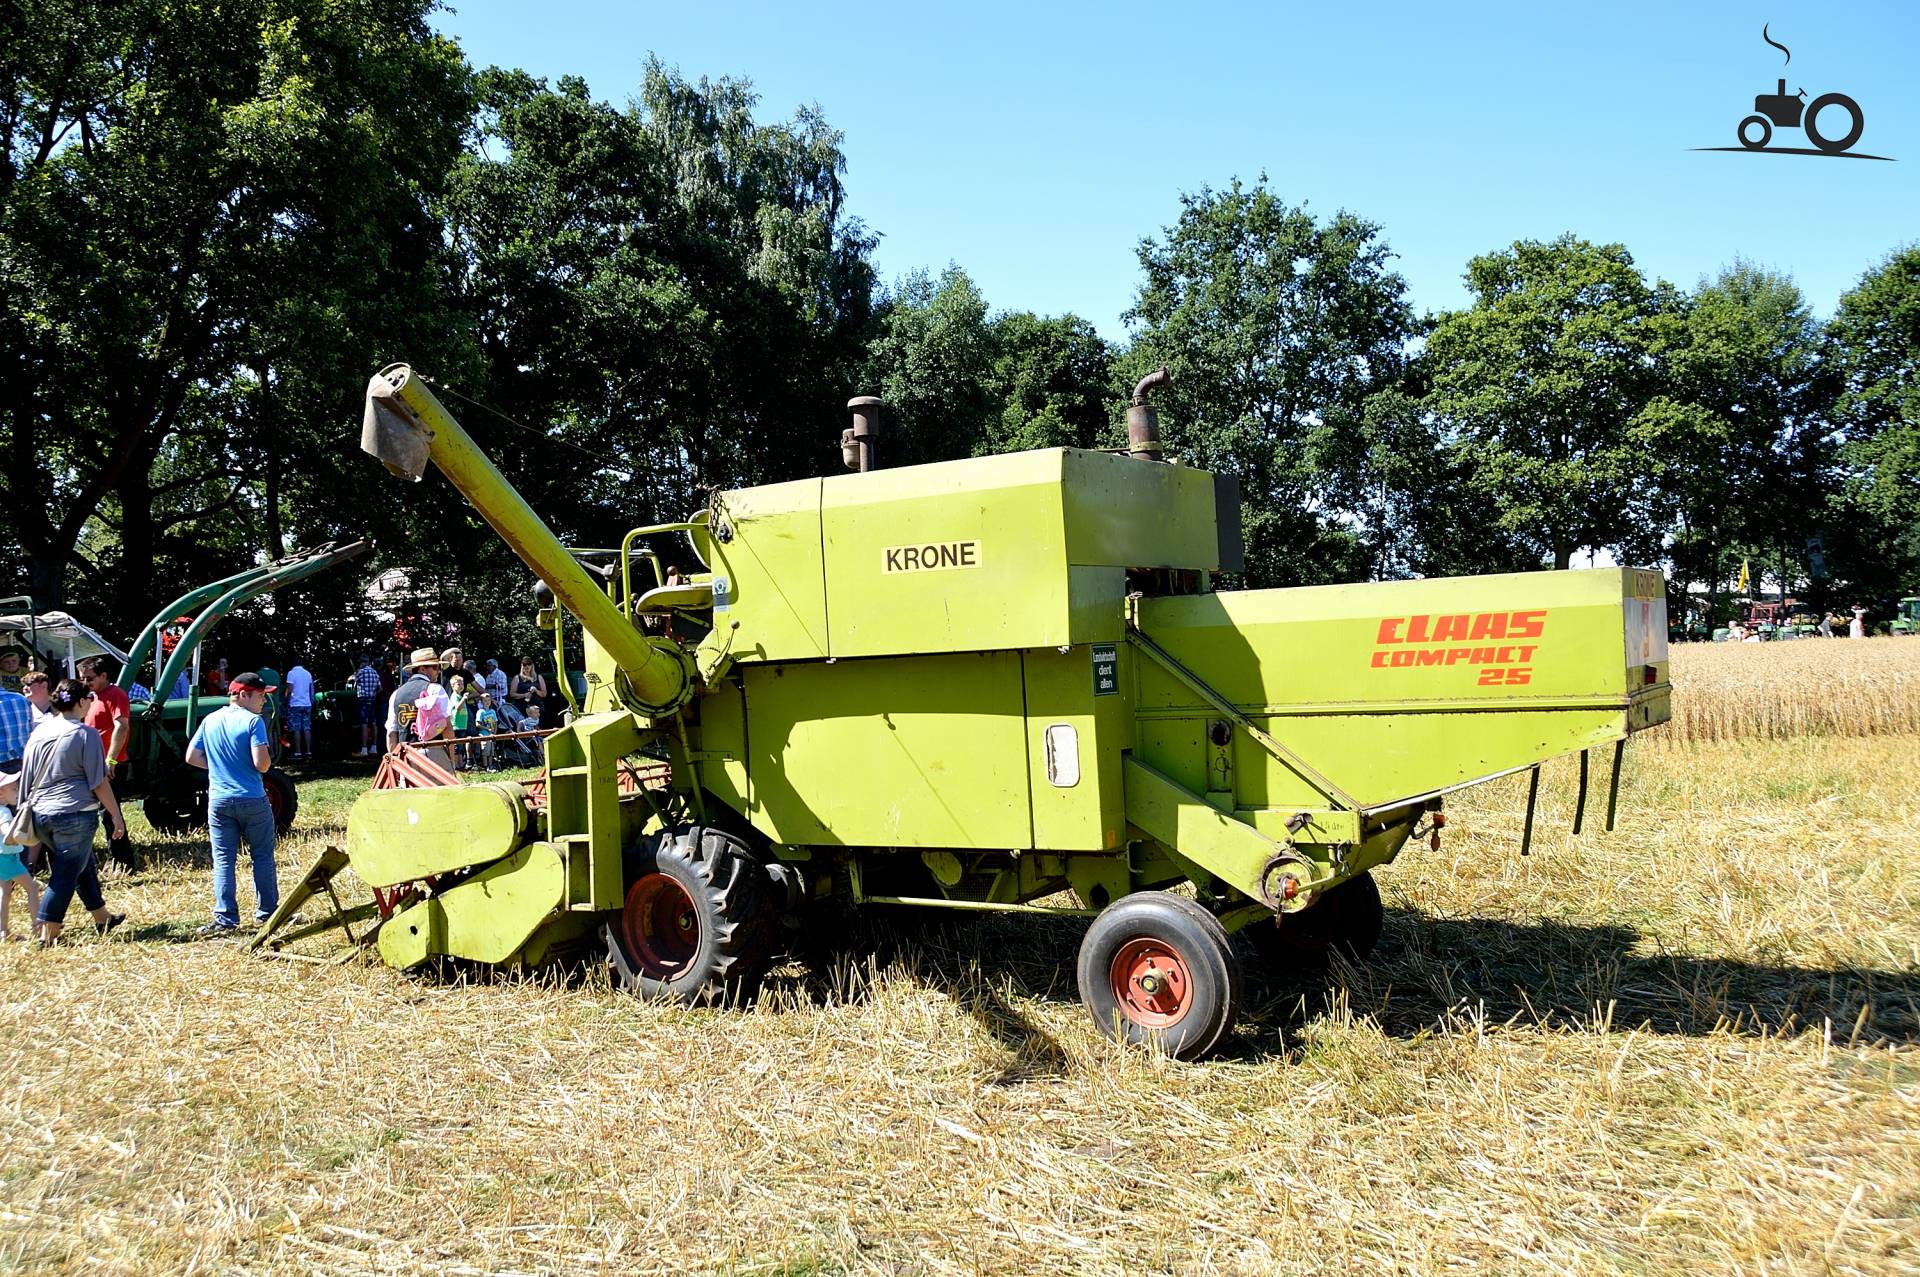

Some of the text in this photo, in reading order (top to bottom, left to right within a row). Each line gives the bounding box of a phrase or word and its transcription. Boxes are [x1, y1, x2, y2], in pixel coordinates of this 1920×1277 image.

[886, 542, 976, 572] KRONE
[1376, 610, 1548, 645] CLAAS
[1370, 645, 1538, 668] COMPACT
[1477, 667, 1533, 686] 25
